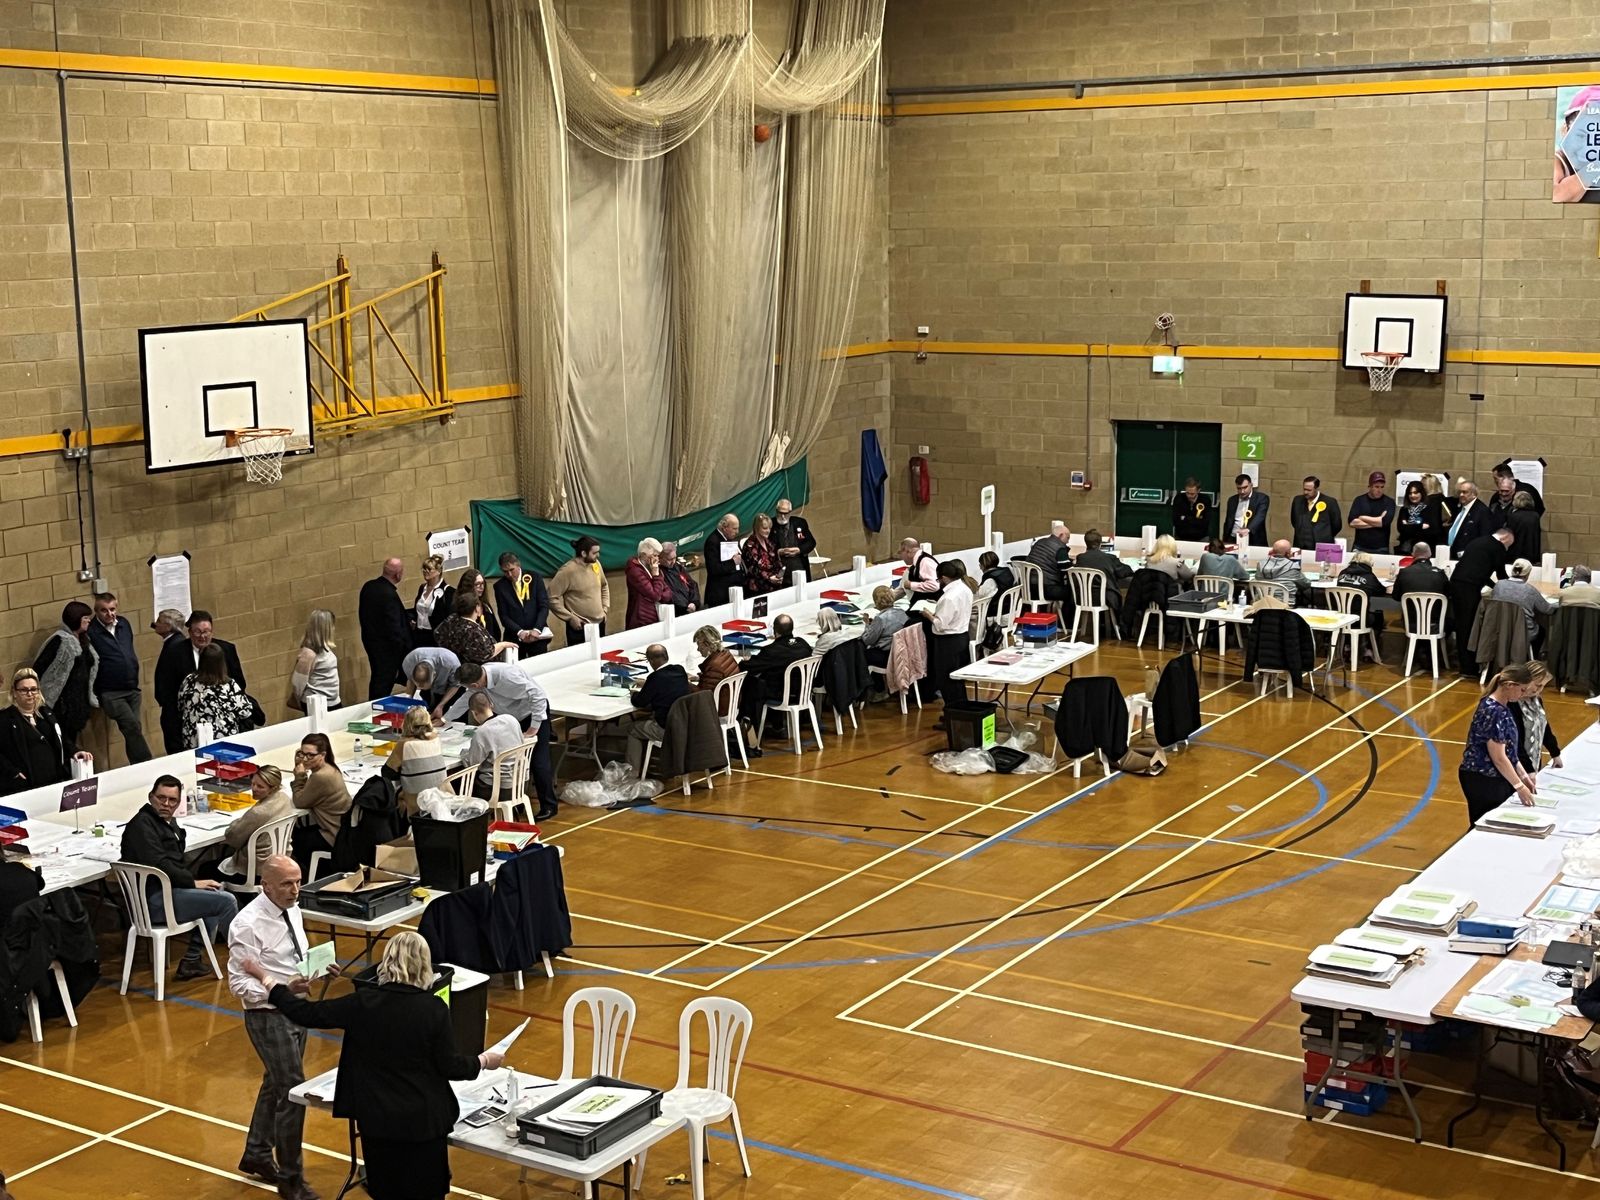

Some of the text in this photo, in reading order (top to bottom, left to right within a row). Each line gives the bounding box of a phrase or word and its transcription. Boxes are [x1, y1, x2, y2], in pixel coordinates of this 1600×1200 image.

[1241, 434, 1261, 442] Court
[1247, 443, 1256, 457] 2
[63, 784, 97, 798] Count Team
